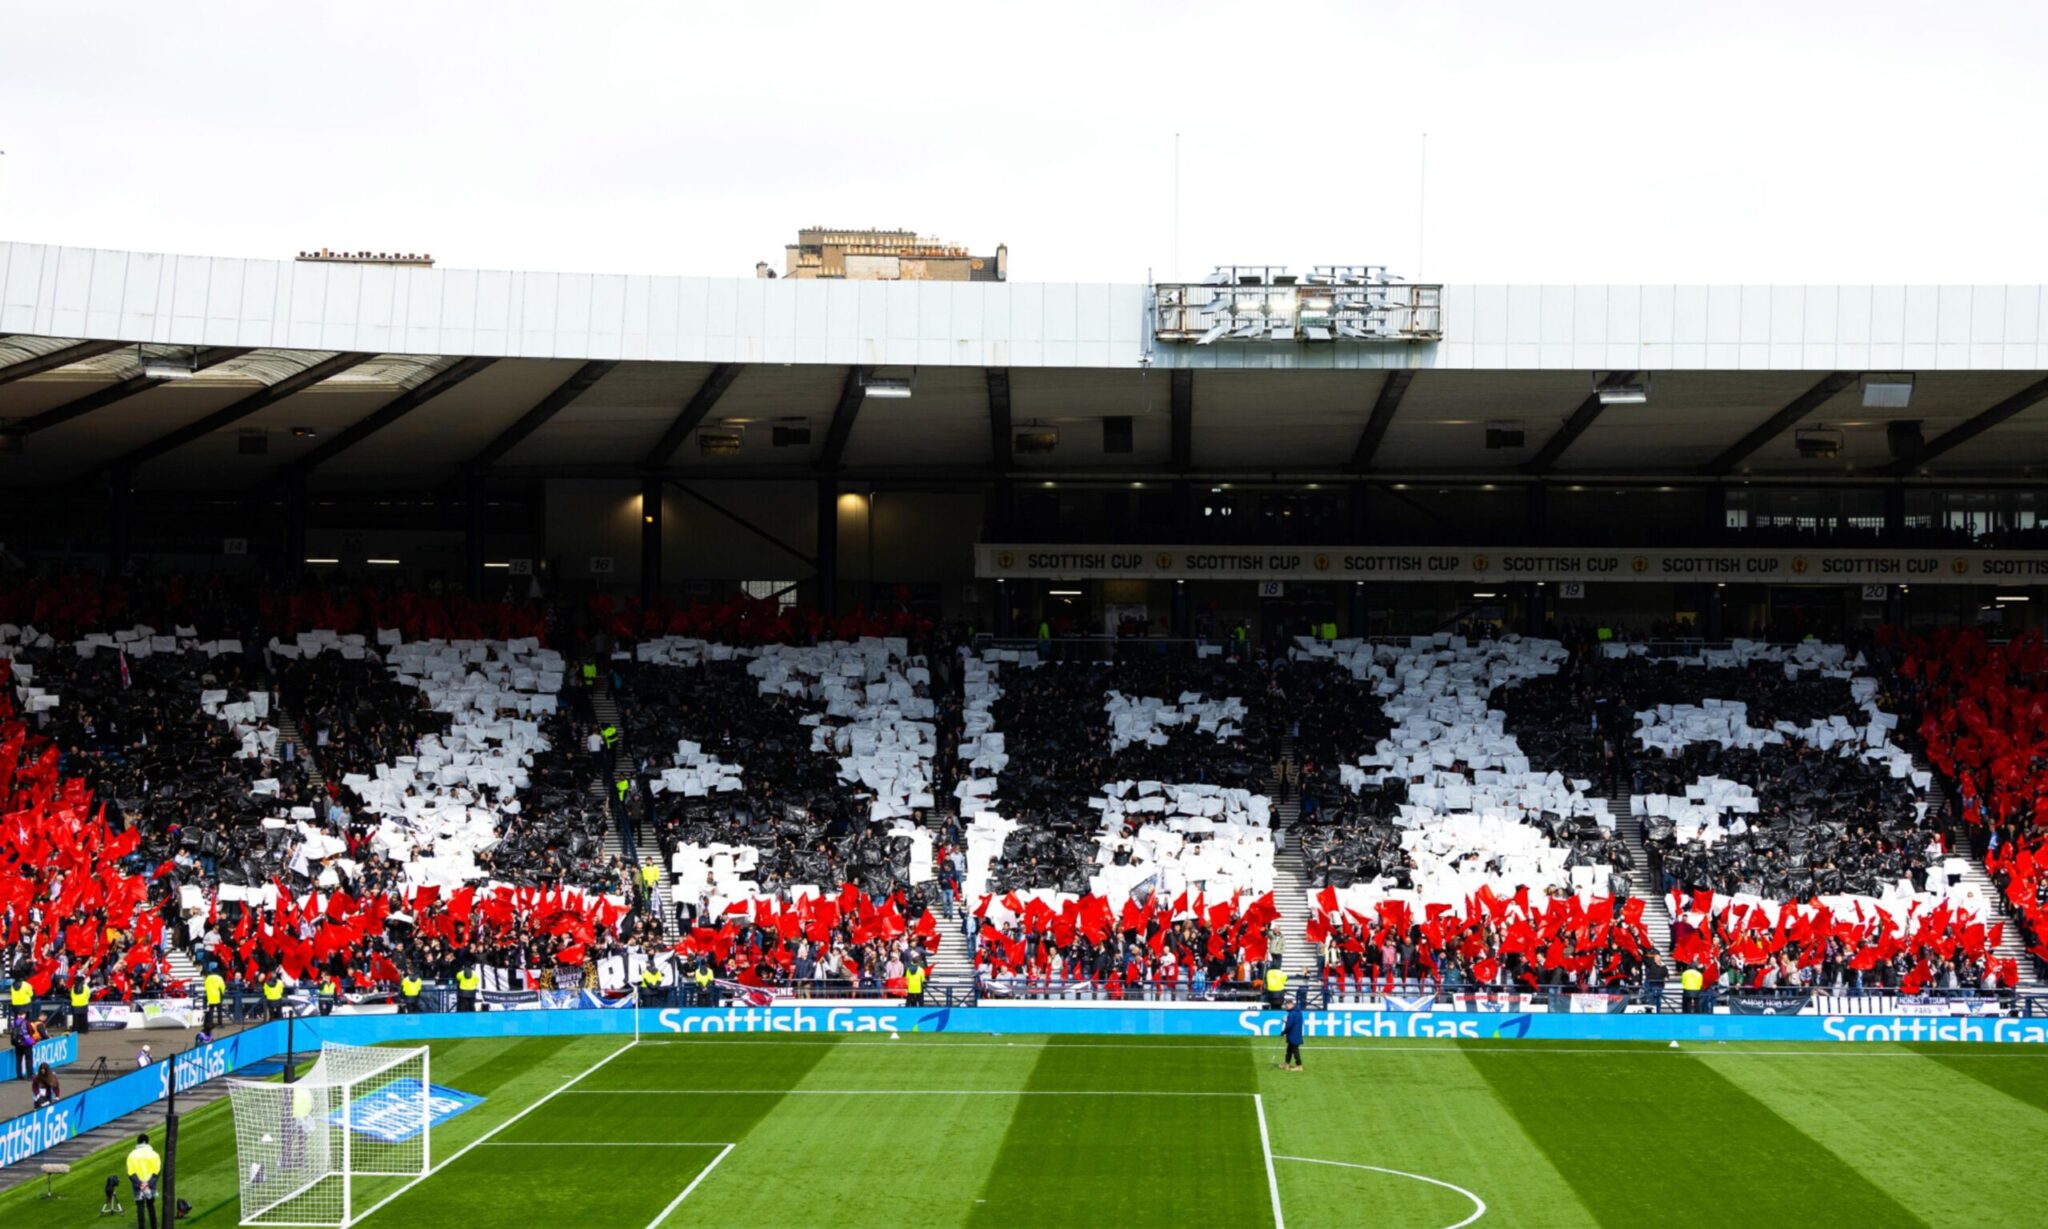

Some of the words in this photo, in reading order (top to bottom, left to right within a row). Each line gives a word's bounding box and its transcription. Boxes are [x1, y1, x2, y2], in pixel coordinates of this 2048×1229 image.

[512, 560, 529, 573] 15
[595, 559, 609, 570] 16
[1028, 553, 1104, 569] SCOTTISH
[1111, 553, 1141, 569] CUP
[1186, 554, 1262, 570] SCOTTISH
[1269, 554, 1300, 570] CUP
[1344, 555, 1421, 571] SCOTTISH
[1427, 555, 1459, 571] CUP
[1503, 556, 1580, 572] SCOTTISH
[1586, 556, 1617, 572] CUP
[1662, 557, 1739, 573] SCOTTISH
[1746, 557, 1778, 573] CUP
[1822, 558, 1899, 574] SCOTTISH
[1906, 558, 1937, 574] CUP
[1264, 582, 1279, 595] 18
[1565, 583, 1581, 596] 19
[1864, 585, 1884, 598] 20
[658, 1008, 815, 1032] Scottish
[827, 1009, 897, 1032] Gas
[1239, 1011, 1396, 1037] Scttish
[1407, 1013, 1478, 1038] Gas
[1823, 1017, 1983, 1042] Scottish
[205, 1043, 225, 1081] Gas
[44, 1105, 69, 1149] Gas
